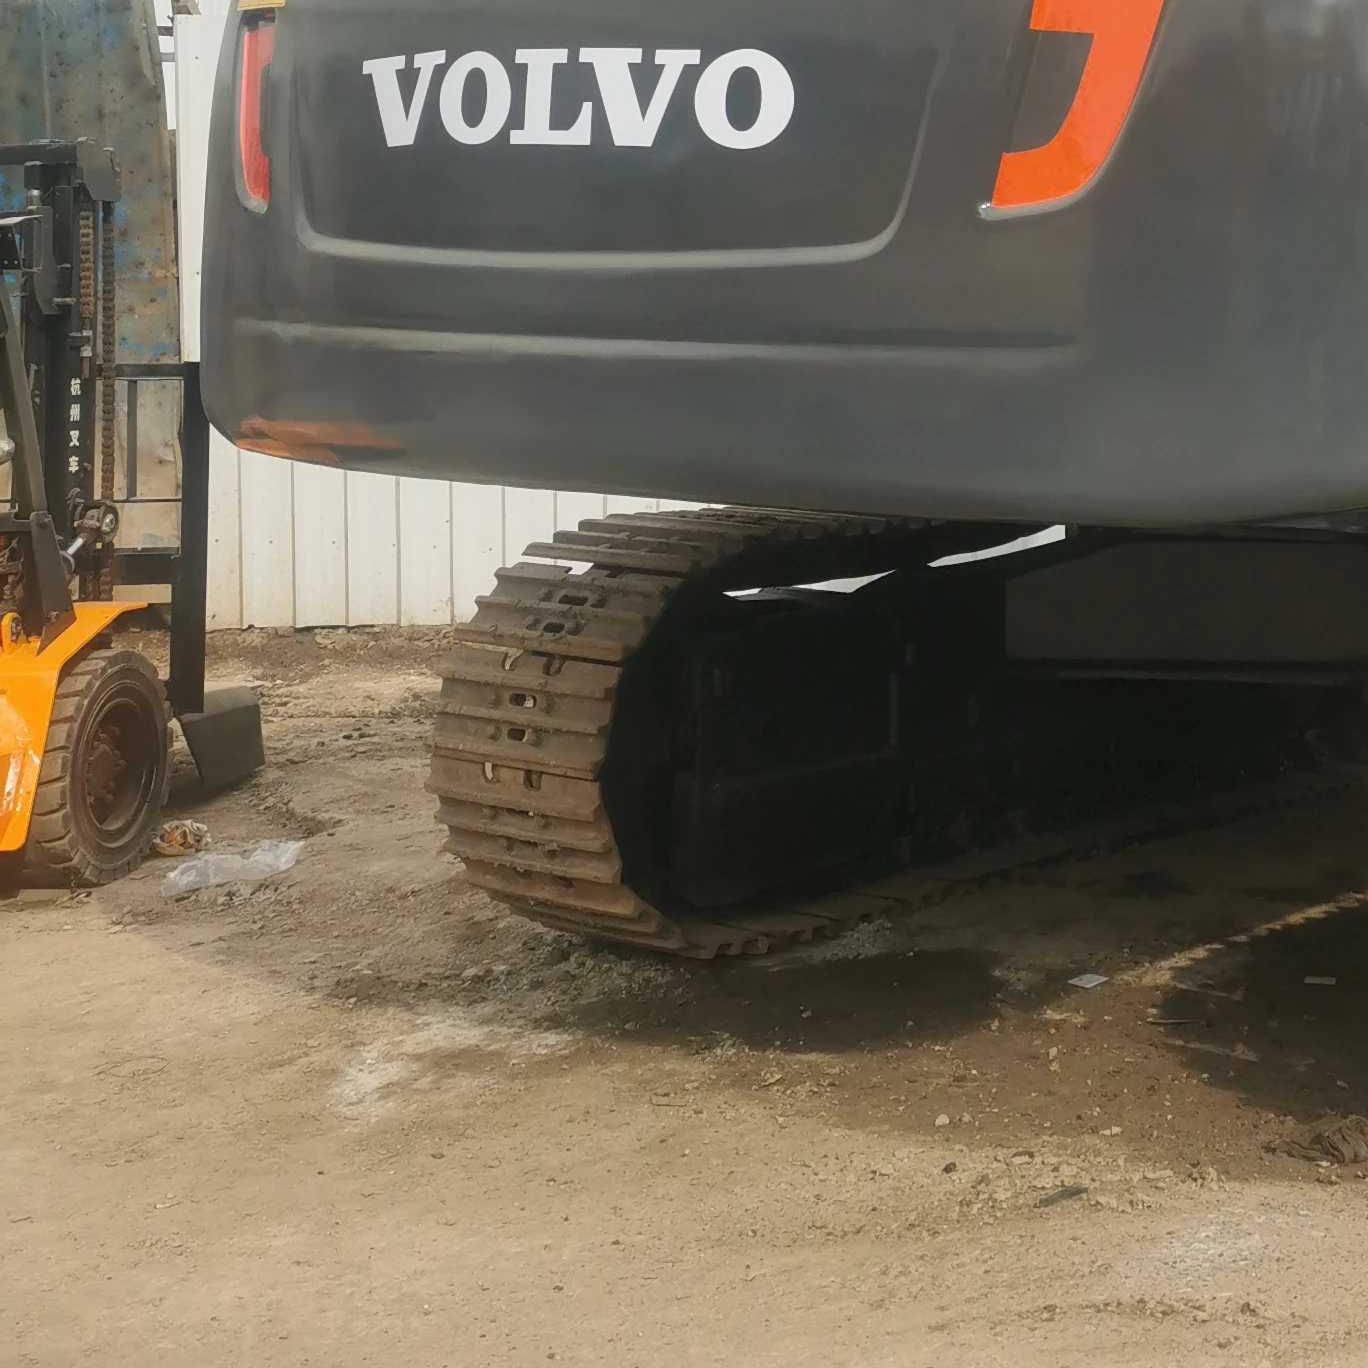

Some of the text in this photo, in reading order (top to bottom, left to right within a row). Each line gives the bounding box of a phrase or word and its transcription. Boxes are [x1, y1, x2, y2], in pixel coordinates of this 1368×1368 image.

[362, 47, 795, 150] VOLVO
[68, 377, 82, 474] 杭州叉车
